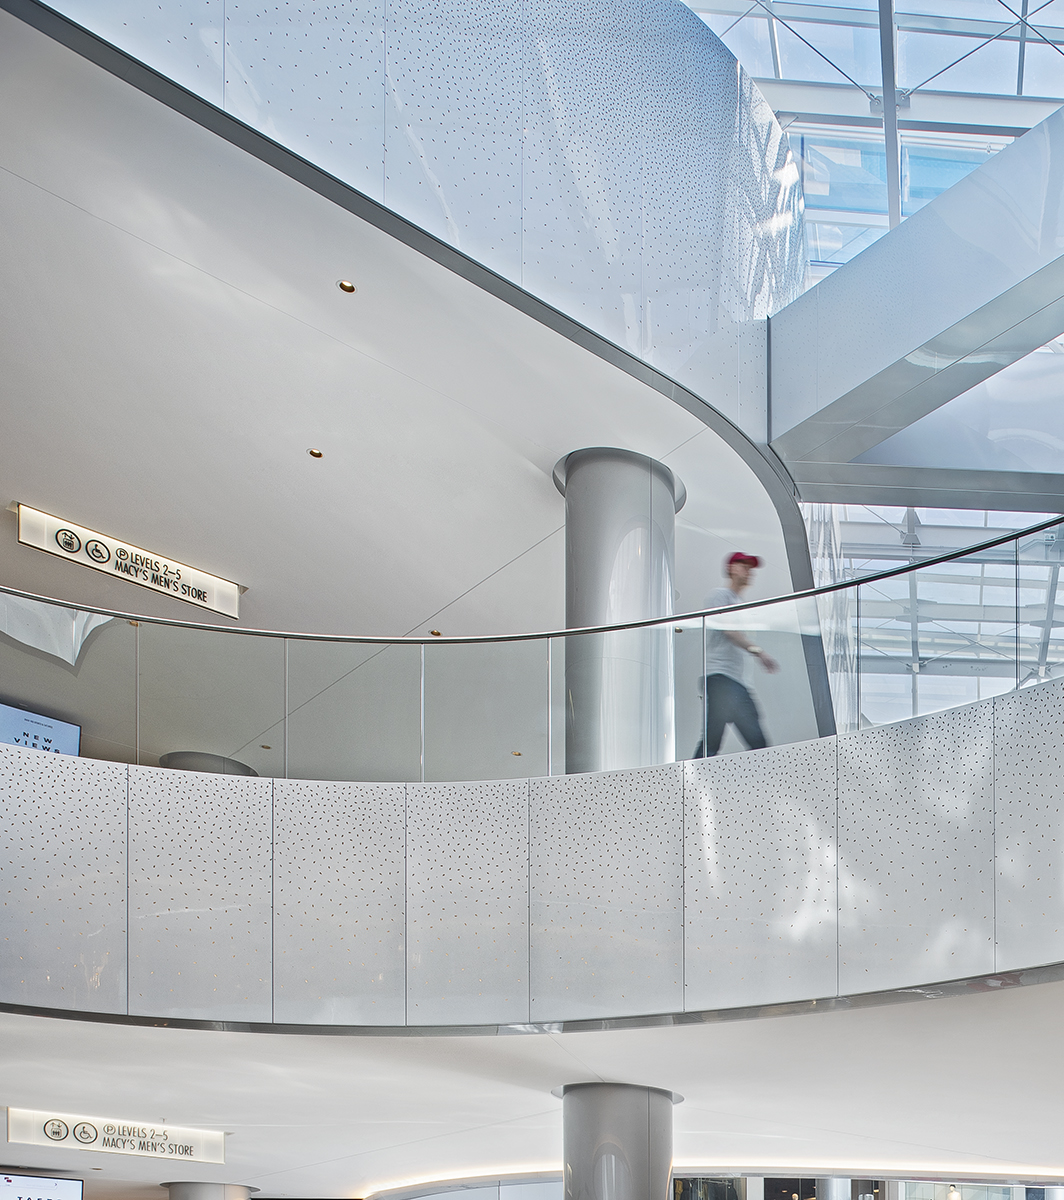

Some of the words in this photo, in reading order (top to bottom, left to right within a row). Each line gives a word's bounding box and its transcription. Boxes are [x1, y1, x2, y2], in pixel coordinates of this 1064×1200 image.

[130, 552, 160, 572] LEVELS
[180, 583, 208, 603] STORE
[22, 731, 53, 744] NEW
[117, 1125, 147, 1139] LEVELS
[168, 1143, 194, 1157] STORE
